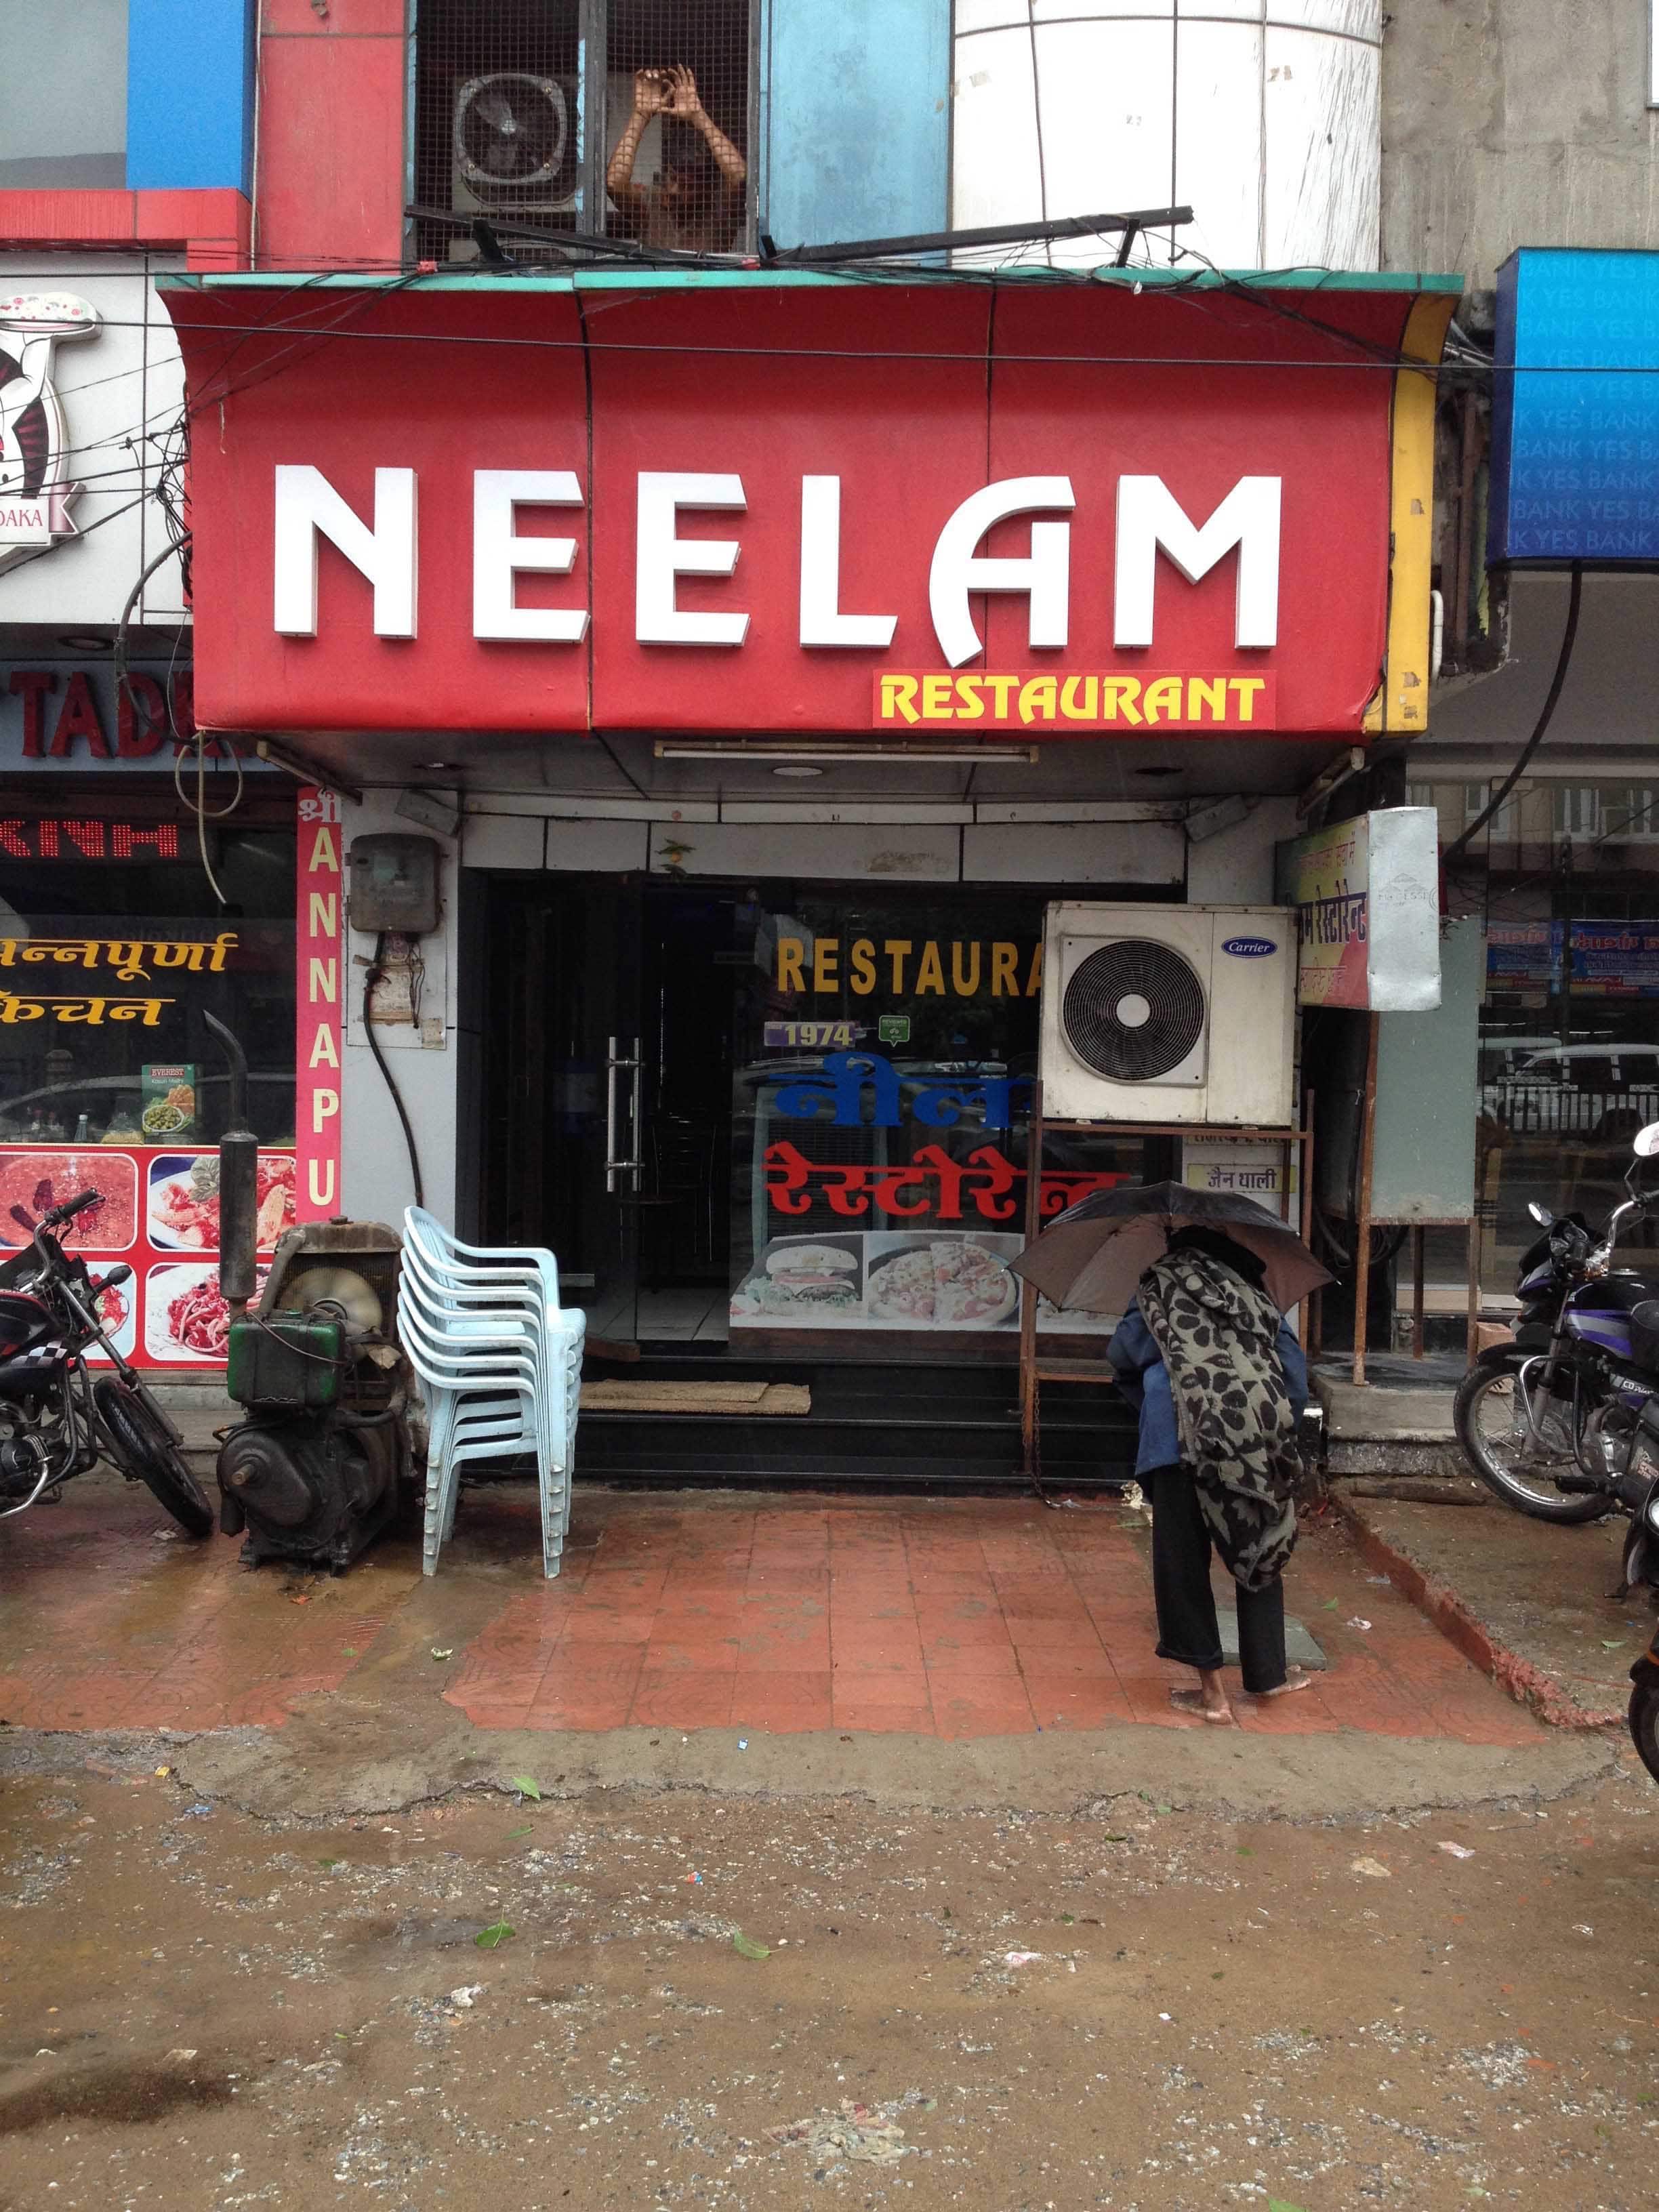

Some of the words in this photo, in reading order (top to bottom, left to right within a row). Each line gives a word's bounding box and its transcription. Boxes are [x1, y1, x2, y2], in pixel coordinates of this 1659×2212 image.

[1520, 259, 1586, 279] BANK
[1594, 259, 1636, 279] YES
[1542, 288, 1585, 308] YES
[1595, 289, 1659, 309] BANK
[1520, 318, 1584, 338] BANK
[1594, 319, 1635, 339] YES
[1542, 349, 1584, 367] YES
[1593, 348, 1658, 367] BANK
[1517, 378, 1586, 398] BANK
[1593, 380, 1633, 400] YES
[1541, 409, 1582, 429] YES
[1591, 409, 1657, 430] BANK
[1515, 439, 1581, 458] BANK
[1589, 439, 1632, 459] YES
[1538, 470, 1580, 489] YES
[1589, 470, 1654, 490] BANK
[1514, 499, 1580, 519] BANK
[1589, 500, 1629, 520] YES
[1536, 530, 1578, 550] YES
[1587, 530, 1652, 550] BANK
[274, 464, 1283, 669] NEELAM
[880, 674, 1265, 724] RESTAURANT
[1229, 942, 1270, 953] Carrier
[785, 1023, 853, 1046] 1974
[152, 1068, 184, 1076] EVEREST
[769, 1051, 1041, 1128] नील
[1207, 1166, 1236, 1189] जैन
[1238, 1168, 1277, 1189] थाली
